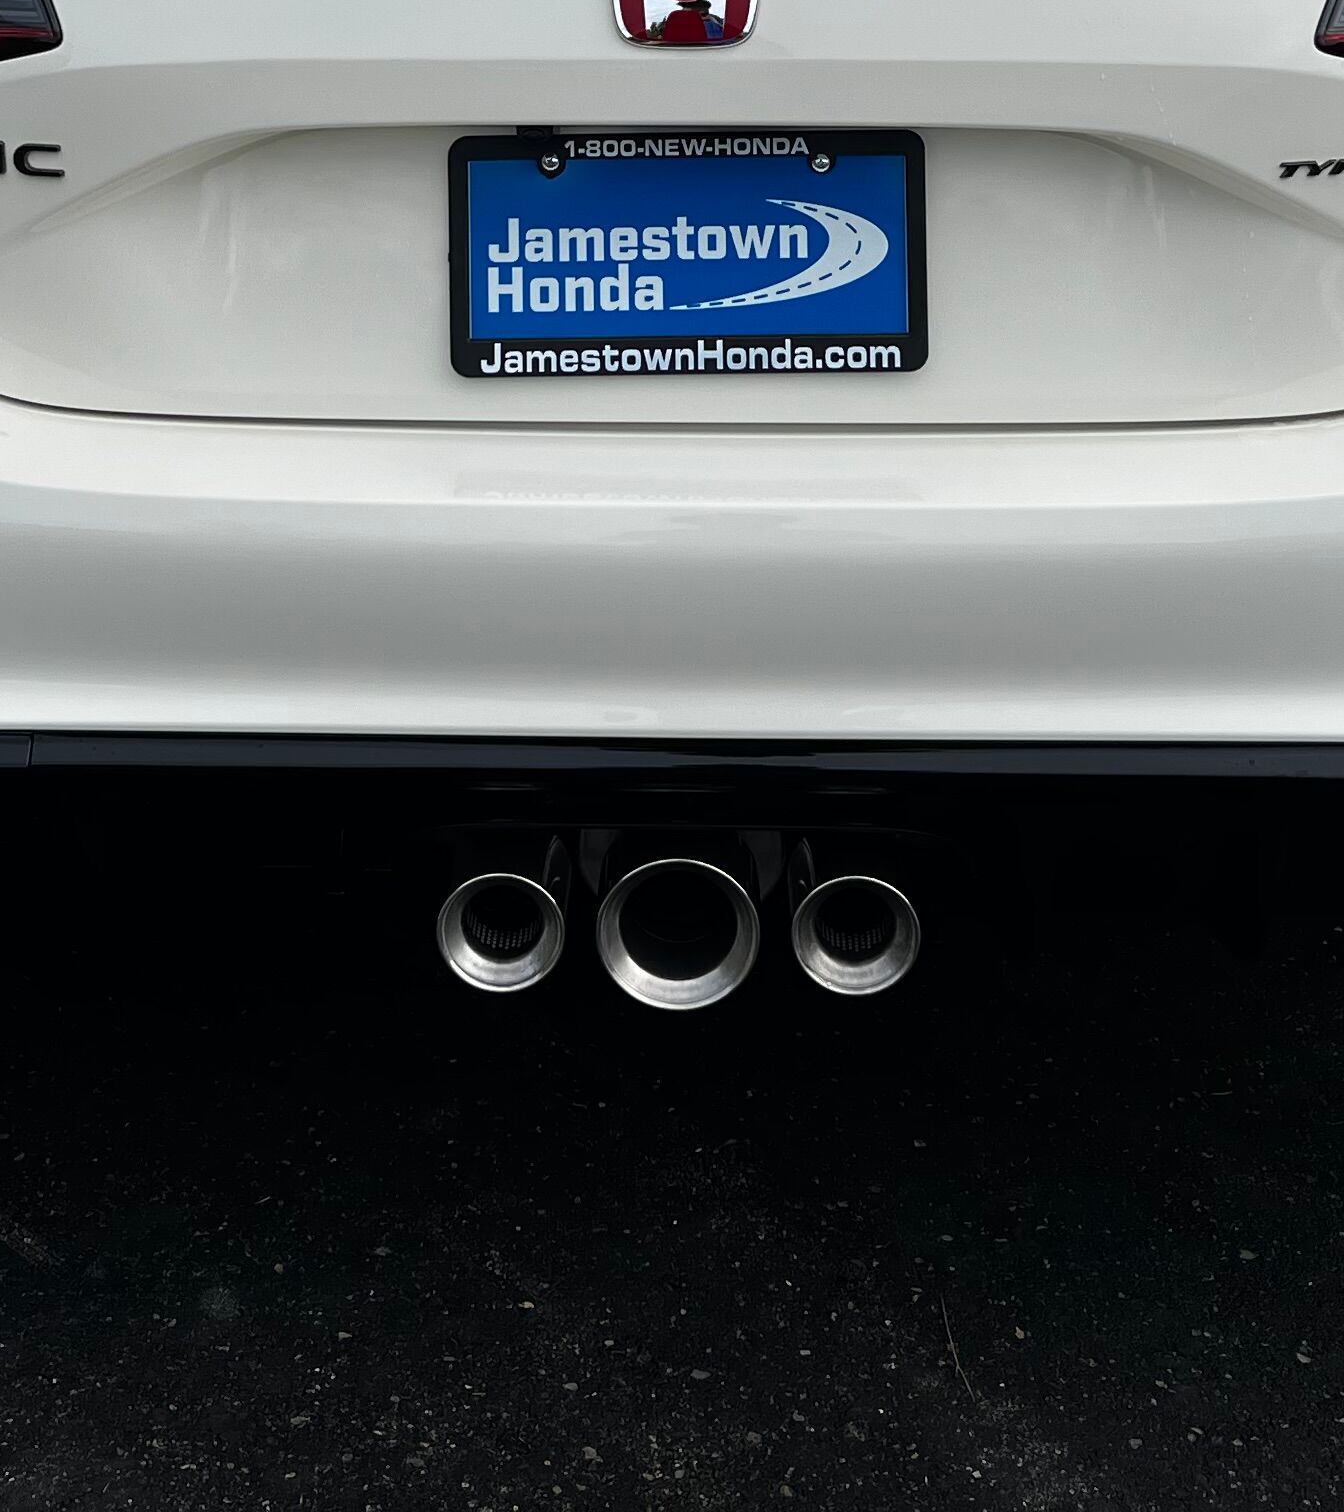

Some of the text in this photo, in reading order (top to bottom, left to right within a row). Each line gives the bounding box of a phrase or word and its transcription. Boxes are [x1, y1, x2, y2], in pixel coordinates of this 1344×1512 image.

[564, 136, 810, 158] 1-800-NEW-HONDA
[487, 216, 810, 263] Jamestown
[487, 263, 665, 313] Honda
[480, 338, 902, 375] JamestownHonda.com
